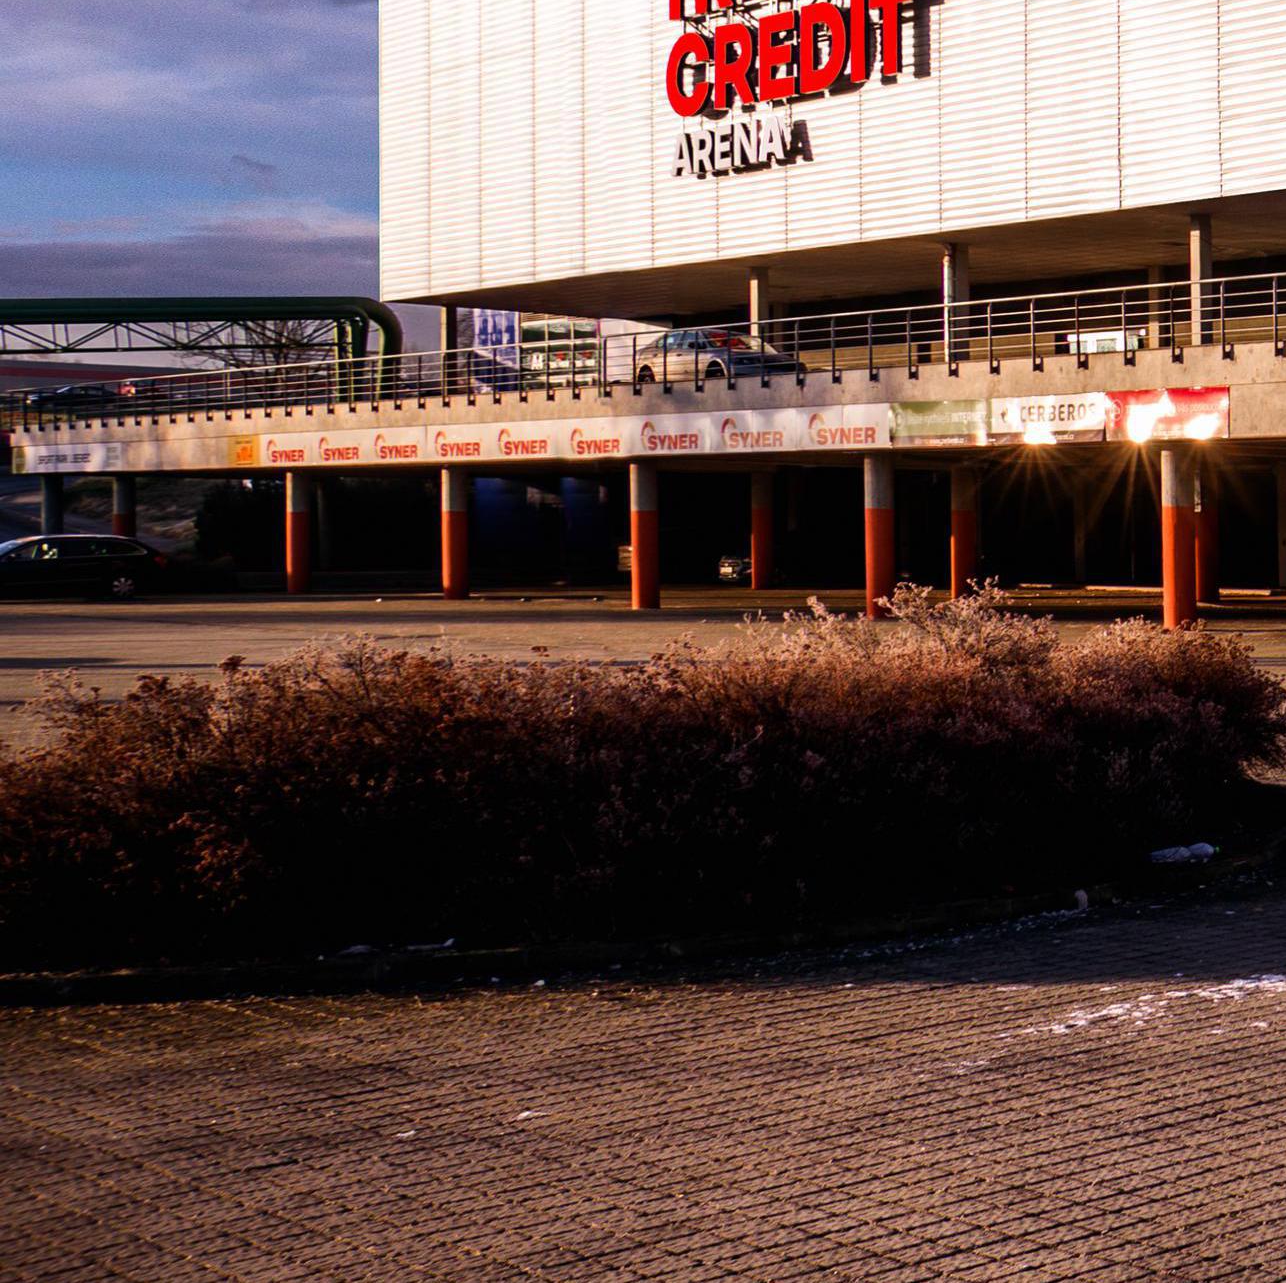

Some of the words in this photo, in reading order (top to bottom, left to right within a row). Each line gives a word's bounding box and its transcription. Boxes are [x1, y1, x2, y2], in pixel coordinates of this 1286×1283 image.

[672, 116, 789, 177] ARENA
[648, 434, 698, 451] SYNER
[729, 430, 784, 448] SYNER
[817, 427, 876, 445] SYNER
[323, 447, 359, 461] SYNER
[379, 445, 418, 459] SYNER
[440, 442, 481, 457] SYNER
[504, 439, 548, 455] SYNER
[576, 439, 620, 455] SYNER
[271, 449, 304, 463] SYNER
